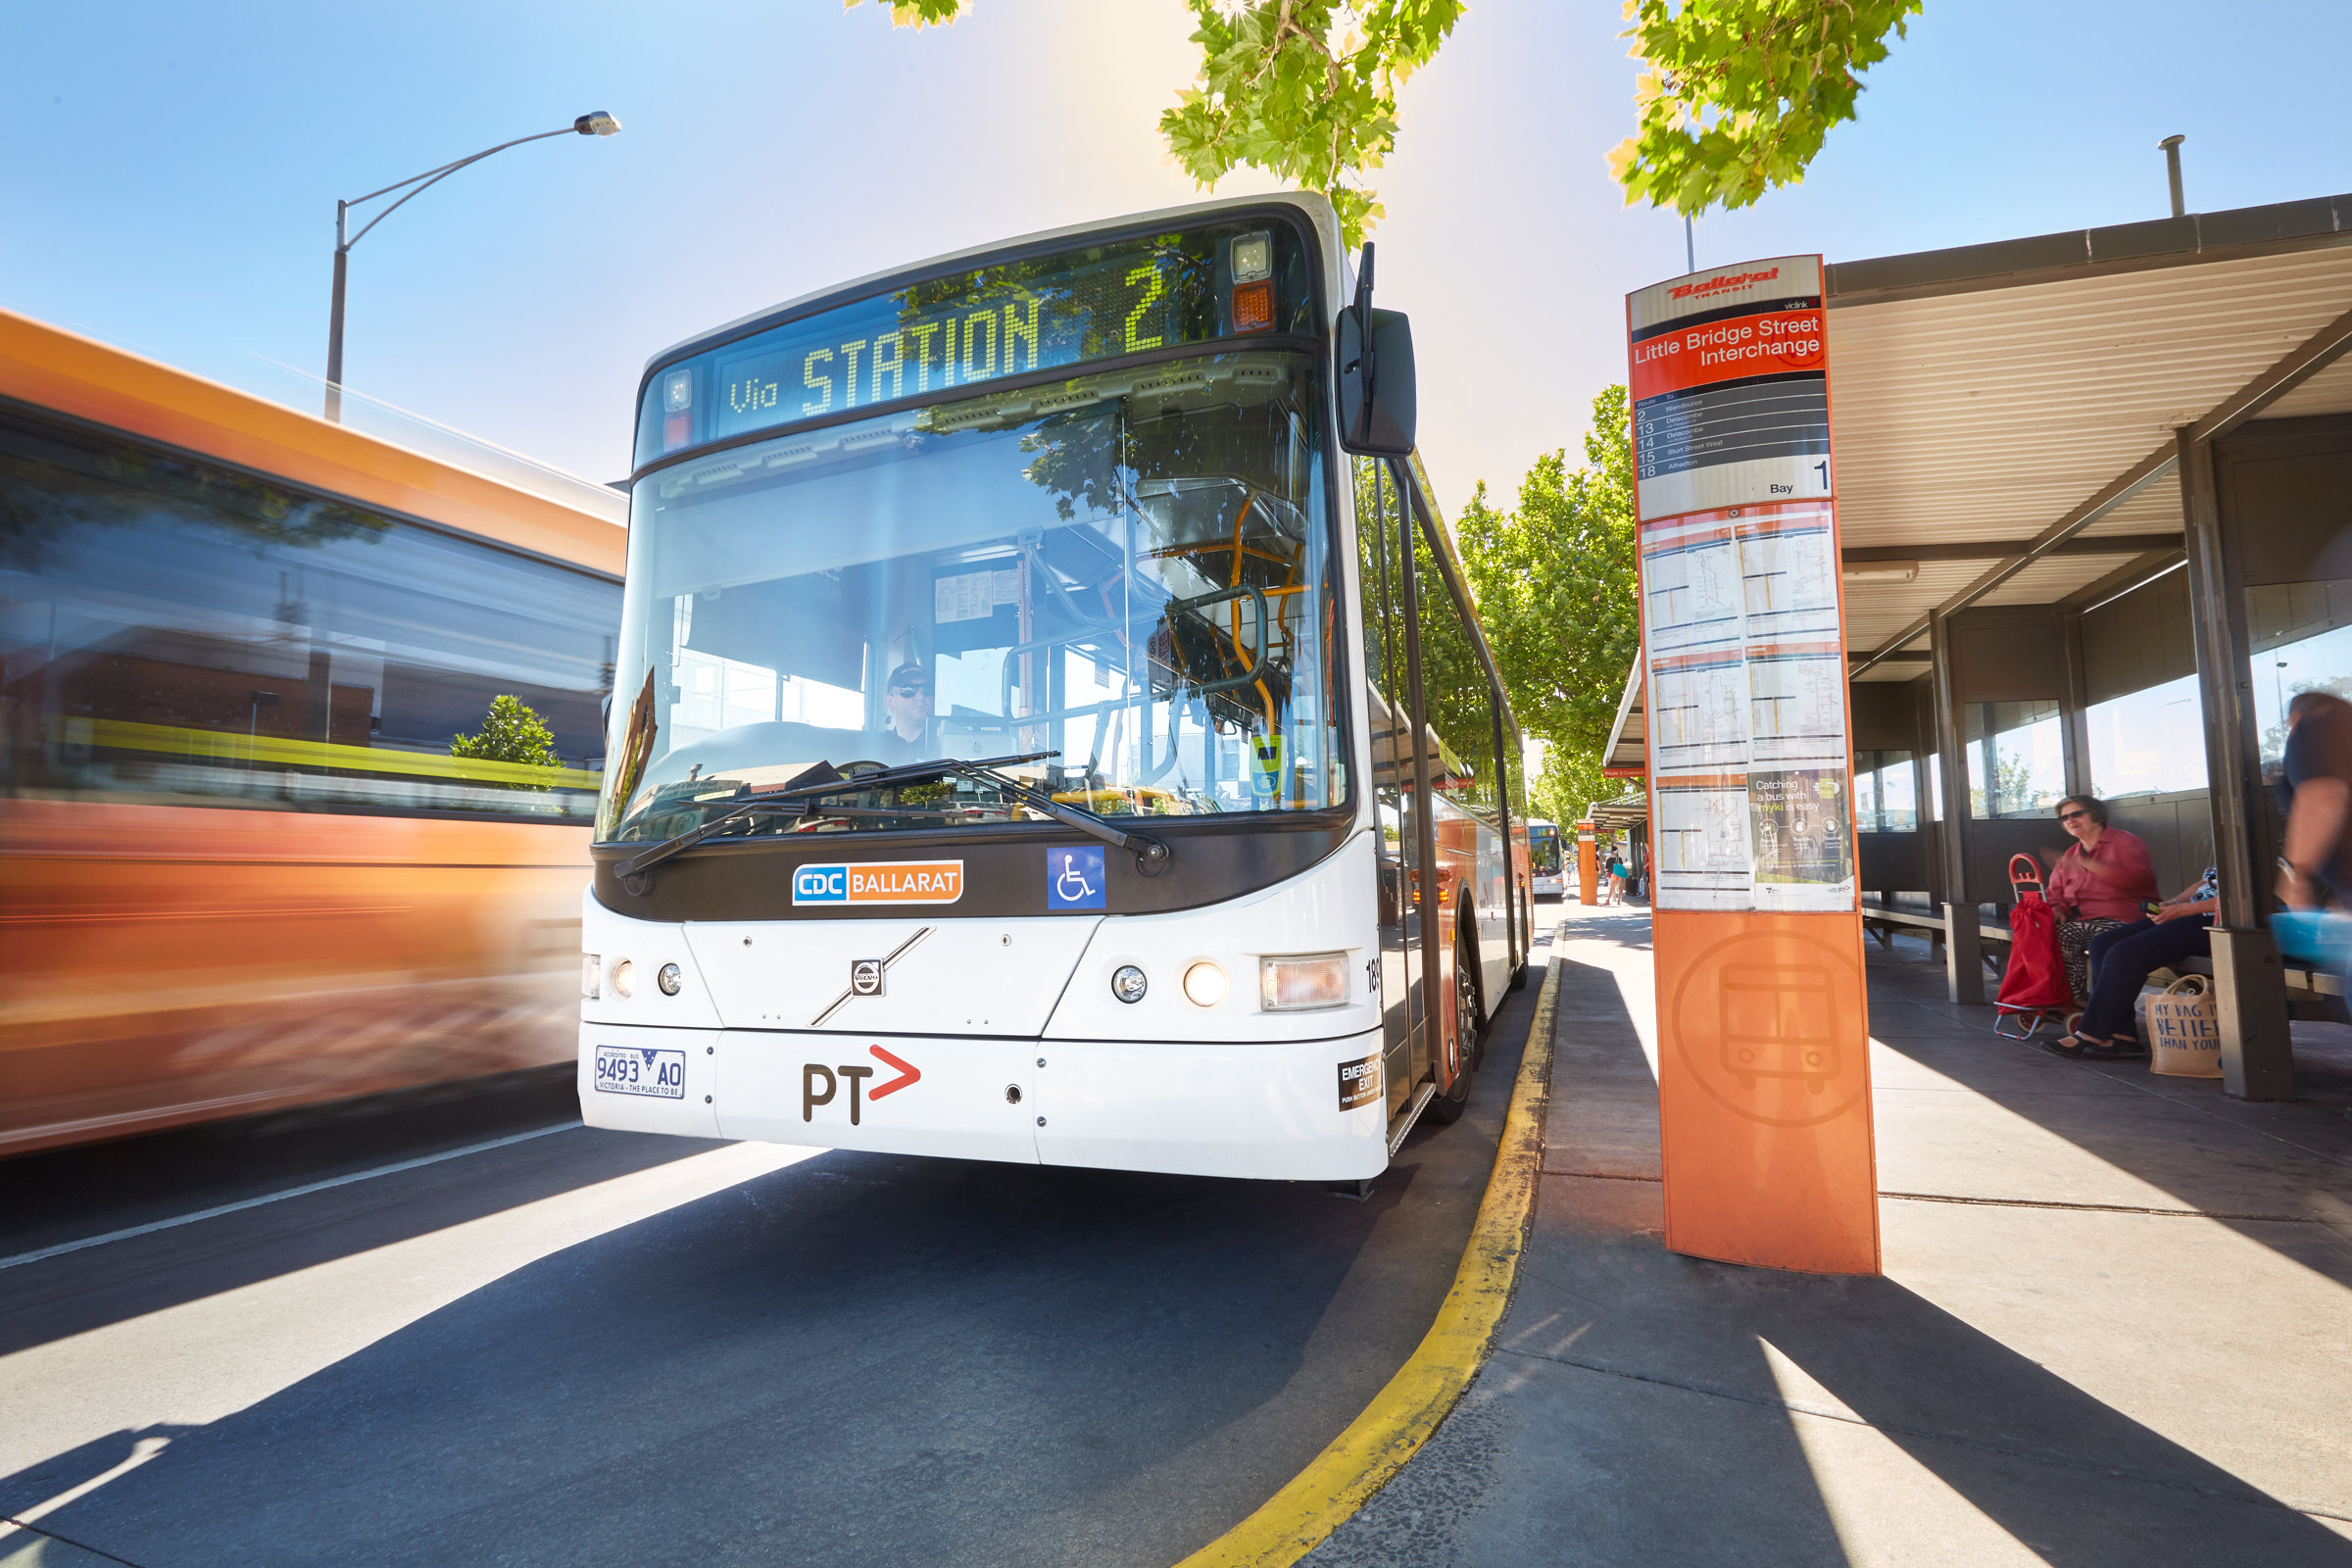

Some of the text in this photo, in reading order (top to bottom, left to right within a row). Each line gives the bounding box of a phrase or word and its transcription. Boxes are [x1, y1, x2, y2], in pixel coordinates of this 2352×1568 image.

[1667, 267, 1780, 300] Ballarat
[1693, 283, 1754, 300] TRANSIT
[1784, 300, 1808, 310] viclink
[730, 265, 1163, 416] Via STATION 2
[1635, 317, 1819, 365] Little Bridge Street
[1701, 338, 1820, 367] Interchange
[1638, 398, 1656, 408] Route
[1638, 400, 1703, 422] 2 Wendouree
[1638, 412, 1703, 436] 13 Delacombe
[1639, 427, 1704, 451] 14 Delacombe
[1640, 451, 1655, 465] 15
[1668, 447, 1684, 456] Sturt
[1705, 439, 1723, 448] West
[1640, 460, 1698, 478] 18 Alfredton
[1770, 460, 1829, 496] Bay 1
[1756, 779, 1798, 791] Catching
[1766, 791, 1785, 802] bus
[1786, 790, 1807, 801] with
[1758, 802, 1820, 814] myki is easy
[799, 872, 957, 895] CDC BALLARAT
[2155, 1004, 2169, 1015] MY
[2159, 1038, 2187, 1051] THAN
[597, 1056, 639, 1083] 9493
[599, 1081, 624, 1091] VICTORIA
[629, 1084, 640, 1093] THE
[641, 1086, 660, 1095] PLACE
[661, 1087, 669, 1096] TO
[1358, 1074, 1374, 1091] EXIT
